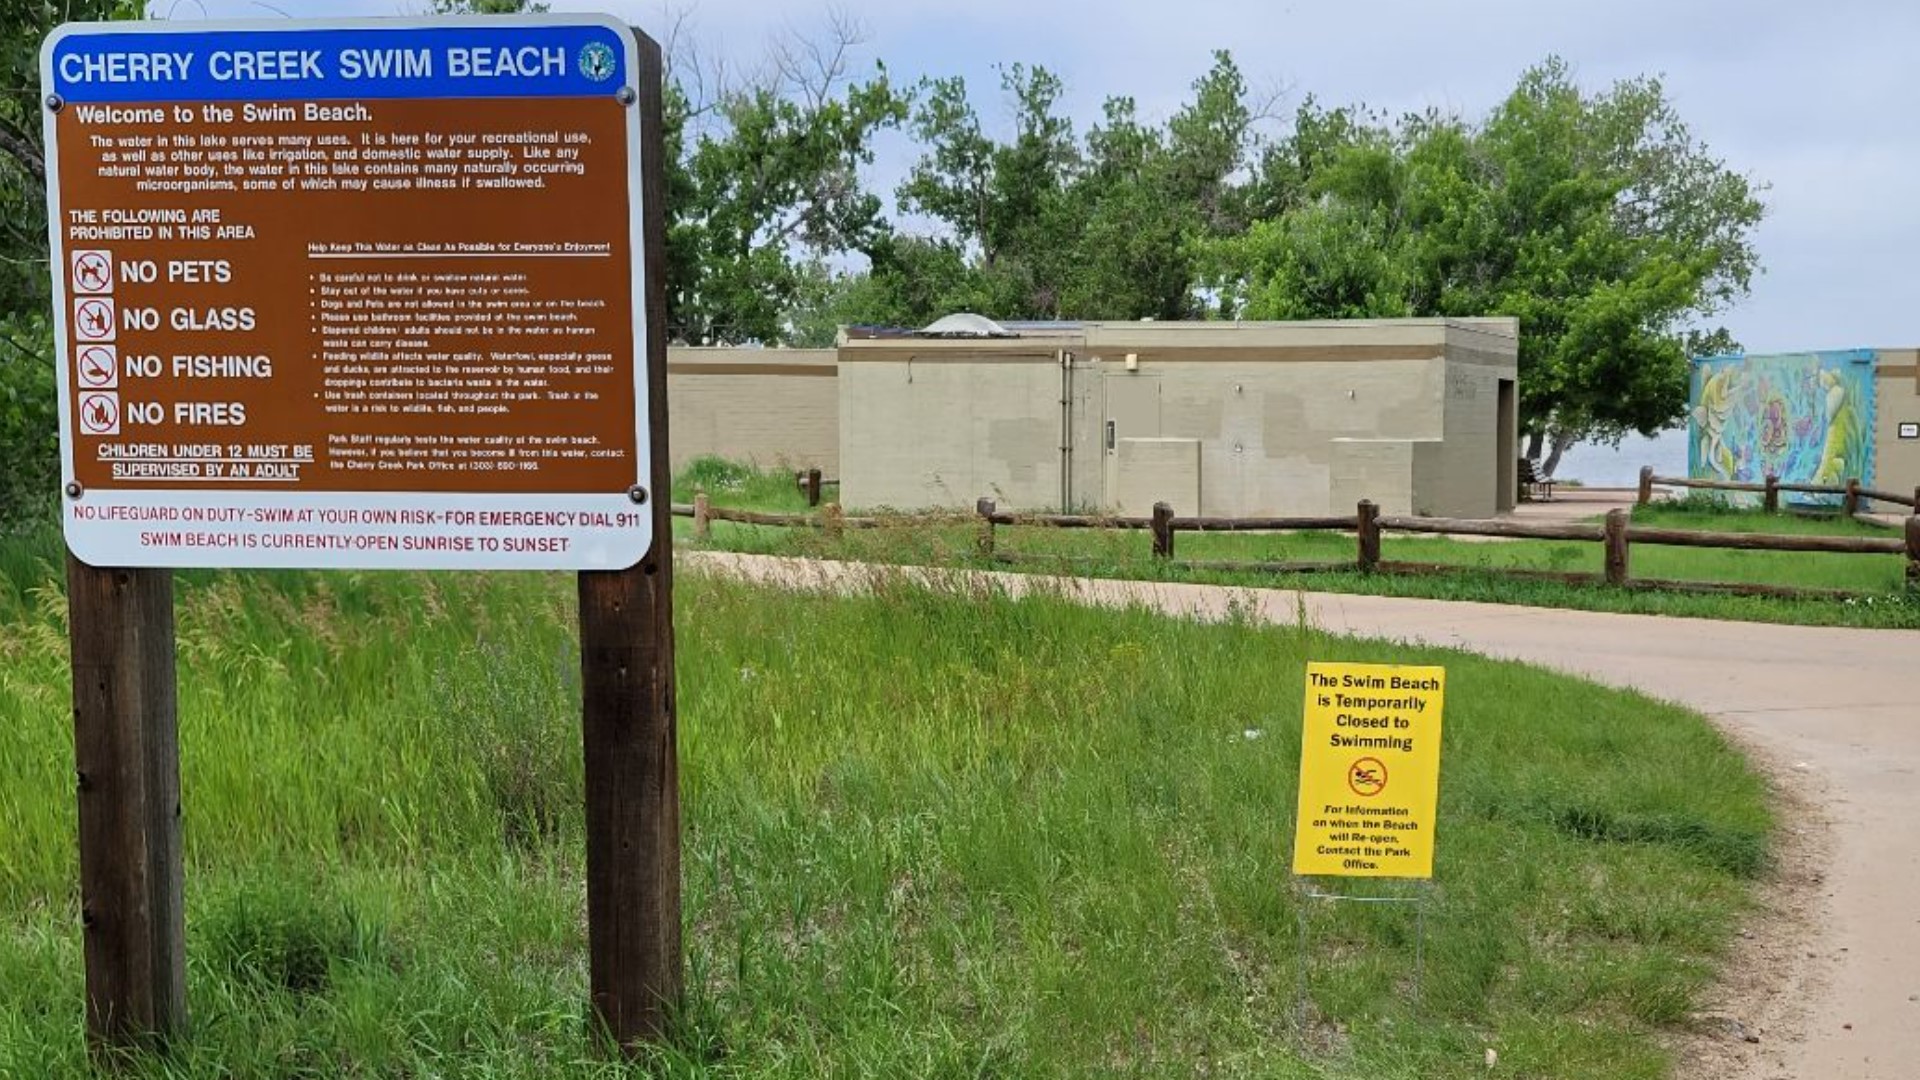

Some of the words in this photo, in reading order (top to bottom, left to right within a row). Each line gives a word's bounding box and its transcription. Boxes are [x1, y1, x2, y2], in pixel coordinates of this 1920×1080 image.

[59, 52, 193, 83] CHERRY
[208, 50, 324, 81] CREEK
[339, 49, 431, 79] SWIM
[447, 46, 565, 77] BEACH
[75, 105, 164, 124] Welcome
[173, 105, 193, 123] to
[202, 104, 233, 123] the
[243, 102, 296, 123] Swim
[304, 102, 372, 121] Beach.
[90, 135, 113, 147] The
[117, 135, 152, 147] water
[157, 135, 168, 147] in
[172, 134, 195, 147] this
[200, 134, 226, 147] lake
[232, 136, 273, 146] serves
[278, 135, 312, 147] many
[317, 135, 350, 145] uses.
[361, 132, 370, 145] It
[374, 132, 386, 145] is
[391, 132, 418, 145] here
[424, 132, 442, 145] for
[449, 134, 476, 147] your
[482, 131, 558, 144] recreational
[564, 133, 590, 144] use,
[101, 152, 117, 162] as
[121, 149, 145, 162] well
[150, 151, 166, 162] as
[170, 149, 202, 162] other
[207, 151, 238, 162] uses
[242, 148, 264, 160] like
[268, 148, 328, 163] irrigation,
[334, 148, 357, 160] and
[361, 147, 420, 160] domestic
[426, 147, 461, 159] water
[467, 147, 513, 161] supply.
[523, 145, 550, 158] Like
[556, 148, 578, 160] any
[98, 164, 140, 177] natural
[144, 164, 178, 177] water
[183, 163, 218, 178] body,
[223, 163, 244, 176] the
[248, 164, 283, 175] water
[288, 162, 299, 175] in
[304, 162, 327, 175] this
[332, 162, 359, 175] lake
[364, 162, 418, 175] contains
[424, 164, 457, 175] many
[463, 161, 517, 175] naturally
[523, 161, 584, 175] occurring
[136, 179, 236, 193] microorganisms,
[242, 180, 276, 190] some
[282, 177, 294, 190] of
[300, 177, 336, 190] which
[341, 179, 367, 191] may
[372, 179, 410, 190] cause
[415, 176, 456, 188] illness
[462, 176, 470, 188] if
[475, 176, 544, 188] swallowed.
[68, 210, 97, 223] THE
[102, 209, 186, 223] FOLLOWING
[191, 208, 219, 223] ARE
[70, 225, 153, 240] PROHIBITED
[158, 225, 172, 239] IN
[178, 225, 210, 240] THIS
[216, 225, 254, 239] AREA
[308, 243, 327, 253] Help
[330, 243, 352, 253] Keep
[355, 242, 372, 251] This
[375, 242, 400, 251] Water
[417, 242, 440, 251] Clean
[444, 243, 456, 251] As
[458, 242, 494, 251] Possible
[497, 242, 511, 251] for
[513, 242, 561, 251] Everyone's
[564, 242, 609, 252] Enjoyment
[120, 260, 156, 283] NO
[168, 260, 230, 283] PETS
[122, 307, 160, 331] NO
[170, 307, 255, 331] GLASS
[126, 355, 162, 377] NO
[172, 355, 271, 377] FISHING
[128, 402, 164, 425] NO
[174, 402, 245, 425] FIRES
[98, 443, 168, 458] CHILDREN
[172, 444, 221, 457] UNDER
[227, 444, 242, 458] 12
[247, 444, 288, 458] MUST
[293, 445, 312, 458] BE
[112, 463, 199, 477] SUPERVISED
[205, 463, 223, 477] BY
[230, 463, 249, 477] AN
[254, 463, 299, 477] ADULT
[74, 505, 95, 520] NO
[98, 505, 178, 521] LIFEGUARD
[182, 507, 203, 521] ON
[296, 509, 313, 523] AT
[318, 509, 357, 524] YOUR
[361, 509, 396, 524] OWN
[478, 511, 576, 526] EMERGENCY
[578, 511, 613, 527] DIAL
[616, 512, 639, 528] 911
[140, 532, 181, 546] SWIM
[185, 532, 238, 547] BEACH
[242, 533, 256, 548] IS
[402, 535, 474, 551] SUNRISE
[477, 537, 498, 552] TO
[502, 537, 568, 552] SUNSET
[1309, 673, 1337, 688] The
[1342, 674, 1384, 689] Swim
[1390, 676, 1439, 691] Beach
[1317, 693, 1330, 707] is
[1335, 693, 1426, 713] Temporarily
[1336, 713, 1388, 729] Closed
[1393, 716, 1409, 729] to
[1329, 733, 1412, 752] Swimming
[1324, 804, 1342, 814] For
[1345, 805, 1408, 816] Information
[1312, 819, 1326, 827] on
[1329, 819, 1358, 829] when
[1362, 820, 1380, 829] the
[1382, 819, 1417, 830] Beach
[1329, 832, 1349, 841] will
[1351, 832, 1398, 844] Re-open,
[1316, 845, 1360, 856] Contact
[1364, 847, 1382, 856] the
[1384, 847, 1410, 856] Park
[1342, 858, 1378, 869] Office.
